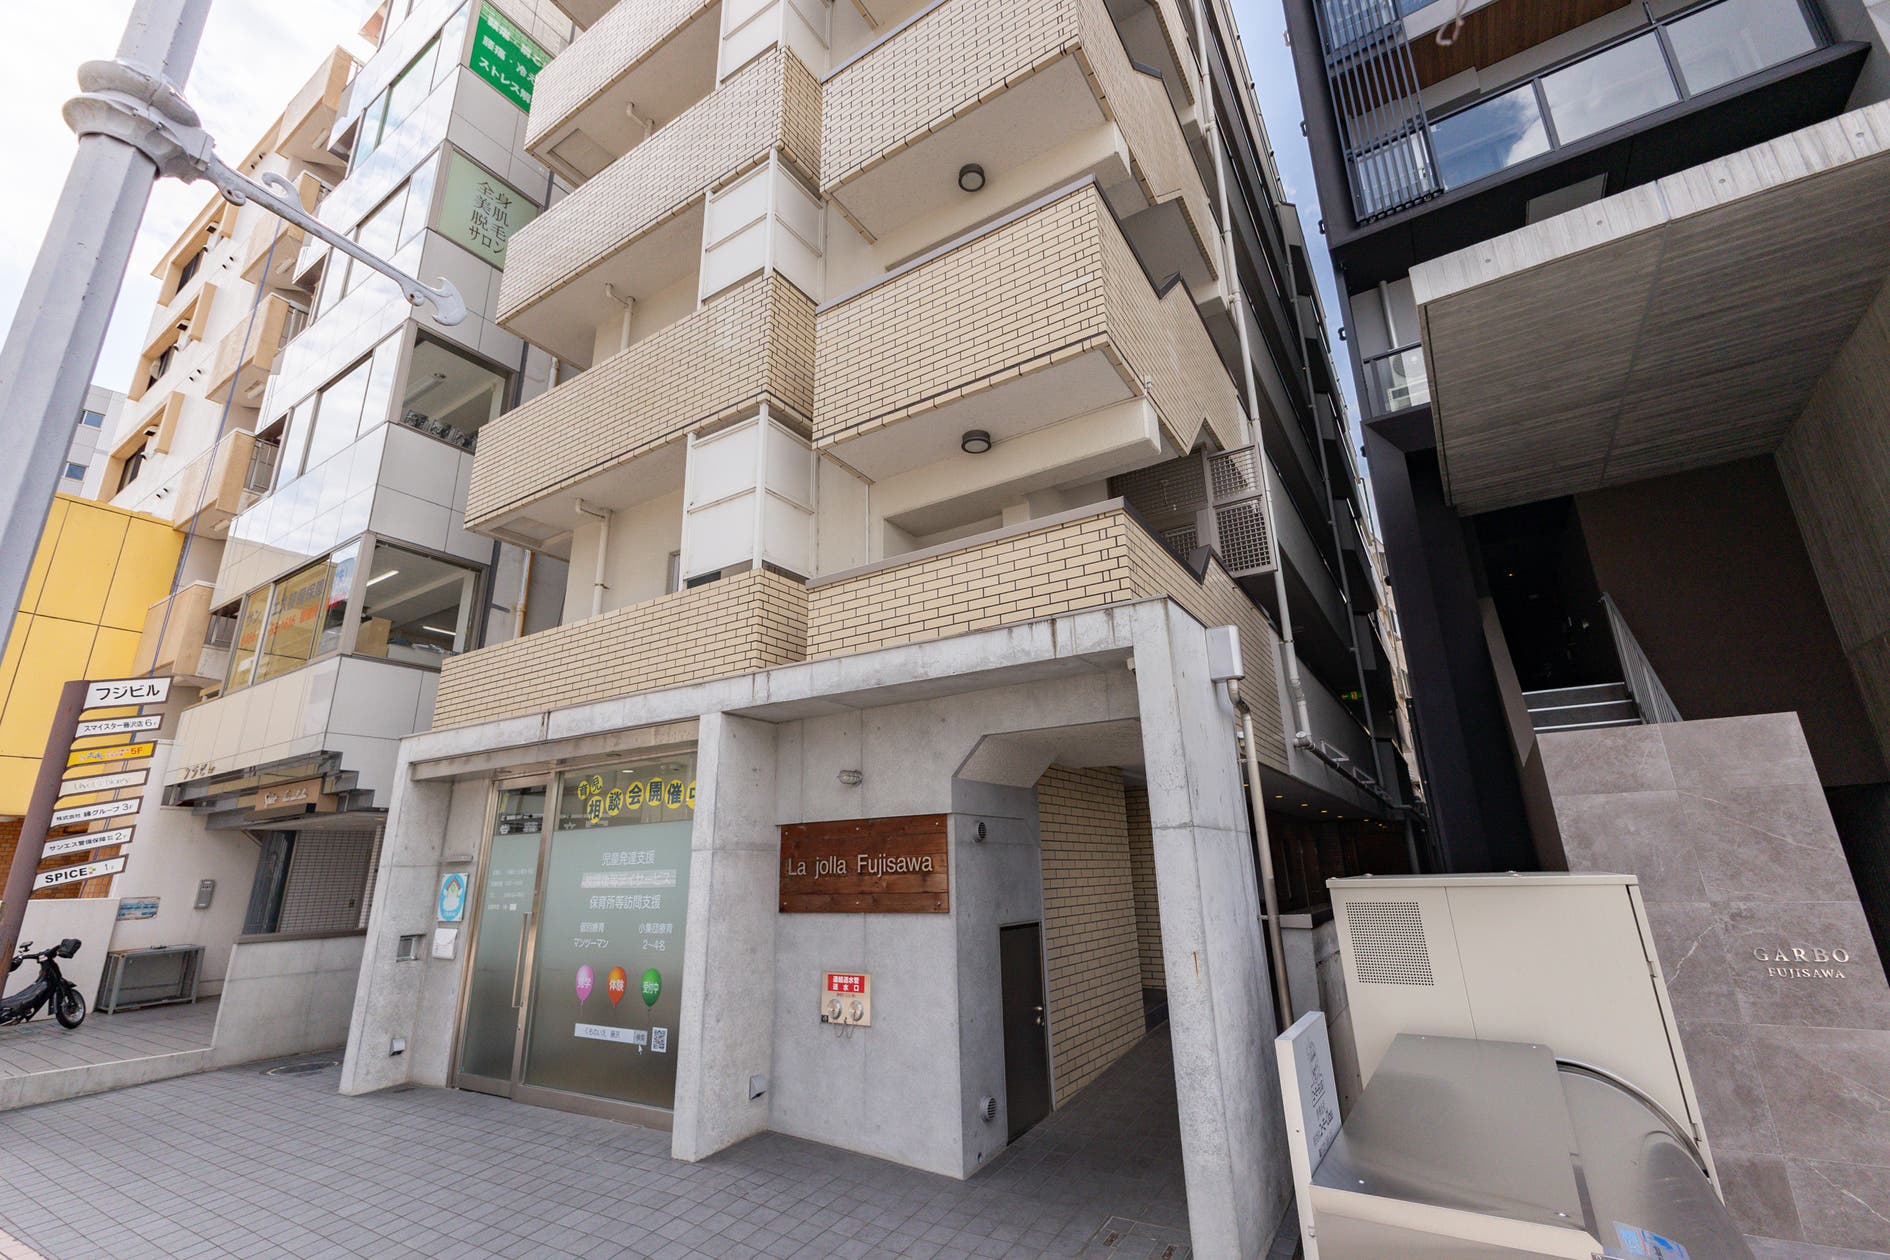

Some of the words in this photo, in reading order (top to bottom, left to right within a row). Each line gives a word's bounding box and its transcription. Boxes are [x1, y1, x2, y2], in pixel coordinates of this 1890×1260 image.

[477, 182, 512, 209] 全身
[470, 210, 506, 242] 脱毛
[469, 225, 505, 253] サロン
[96, 684, 160, 700] フジビル
[45, 867, 88, 883] SPICE
[788, 858, 806, 876] La
[815, 855, 847, 879] jolla
[857, 853, 933, 877] Fujisawa
[1753, 947, 1850, 963] GARBO
[1768, 967, 1846, 979] FUJISAWA
